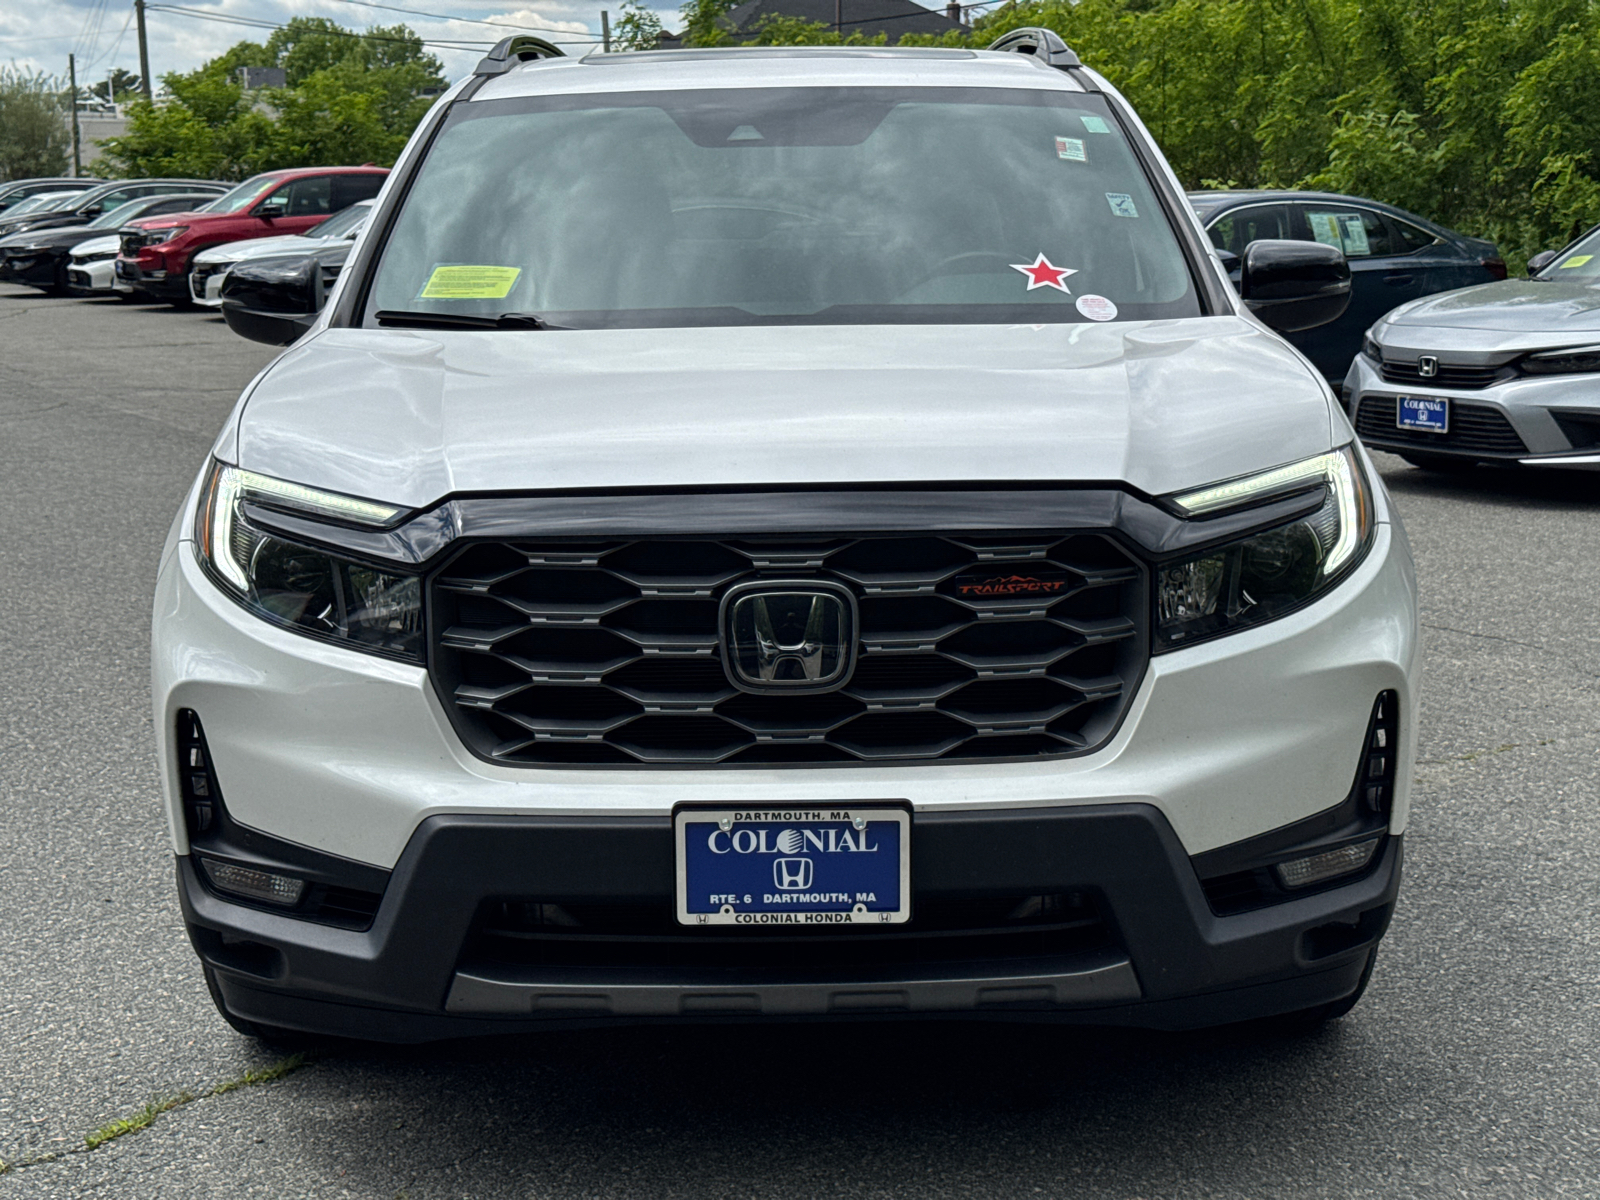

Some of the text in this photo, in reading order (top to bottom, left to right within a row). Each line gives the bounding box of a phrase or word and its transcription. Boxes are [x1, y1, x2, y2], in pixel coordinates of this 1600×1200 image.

[1403, 400, 1443, 411] COLONIAL
[959, 582, 1065, 595] TRAILSPORT
[734, 811, 852, 821] DARTMOUTH, MA
[707, 828, 879, 855] COLONIAL
[709, 892, 877, 904] RTE. 6 DARTMOUTH, MA
[735, 913, 853, 924] COLONIAL HONDA
